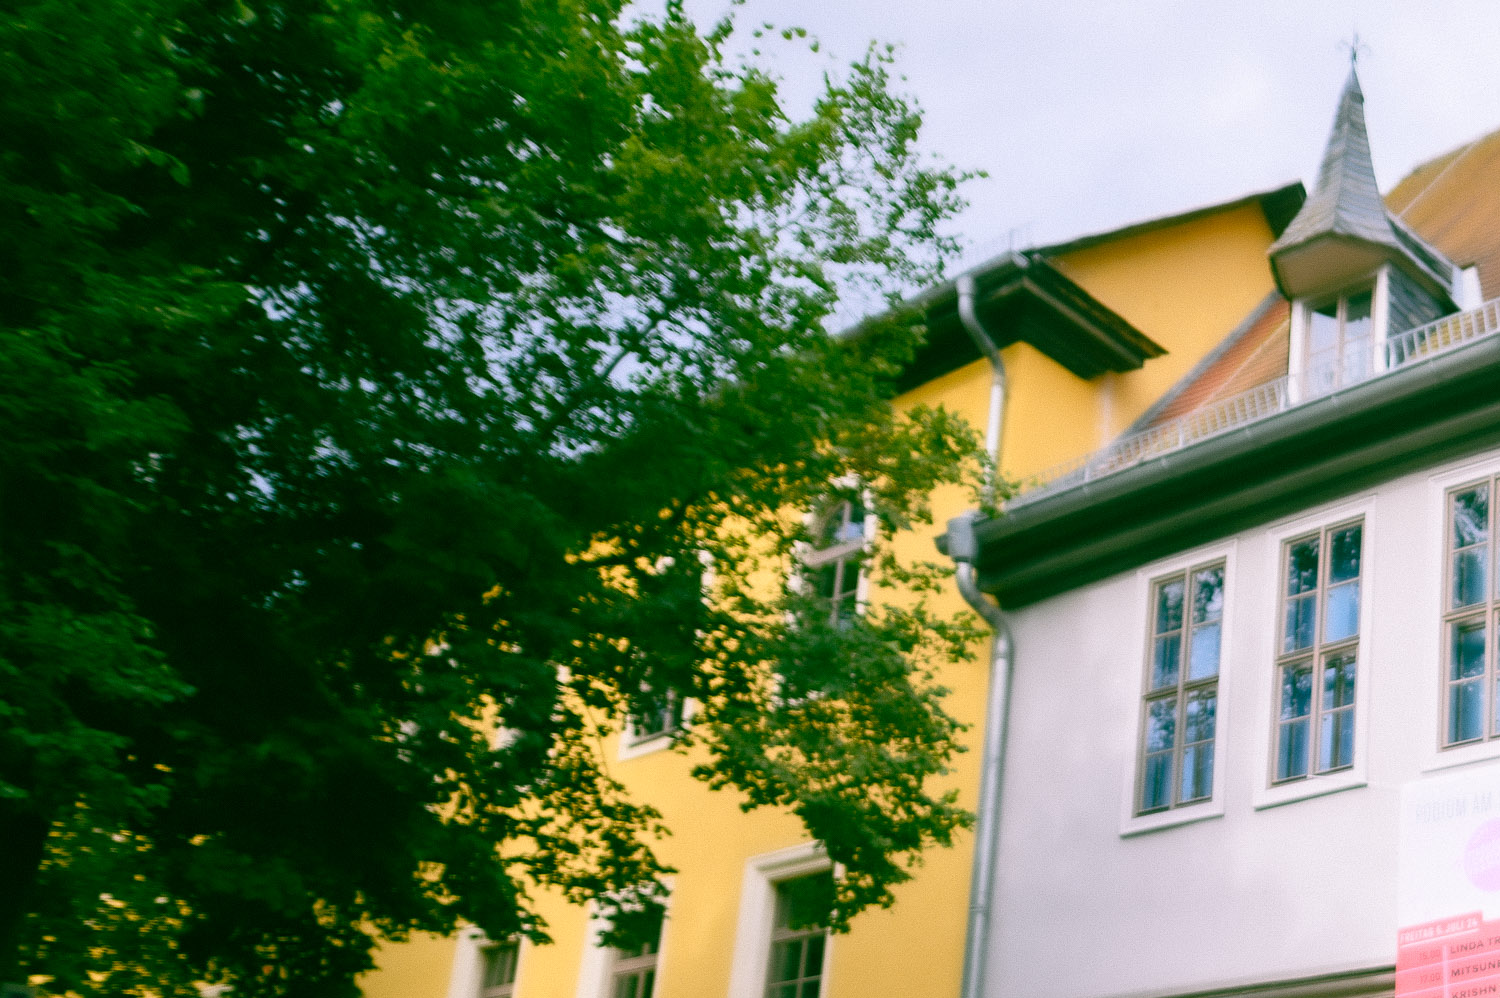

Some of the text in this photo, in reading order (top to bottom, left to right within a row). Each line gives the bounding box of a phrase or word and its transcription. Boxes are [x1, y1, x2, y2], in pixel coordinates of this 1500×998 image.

[1415, 798, 1466, 823] PODIUM
[1473, 791, 1492, 812] AM
[1450, 939, 1484, 954] LINDA
